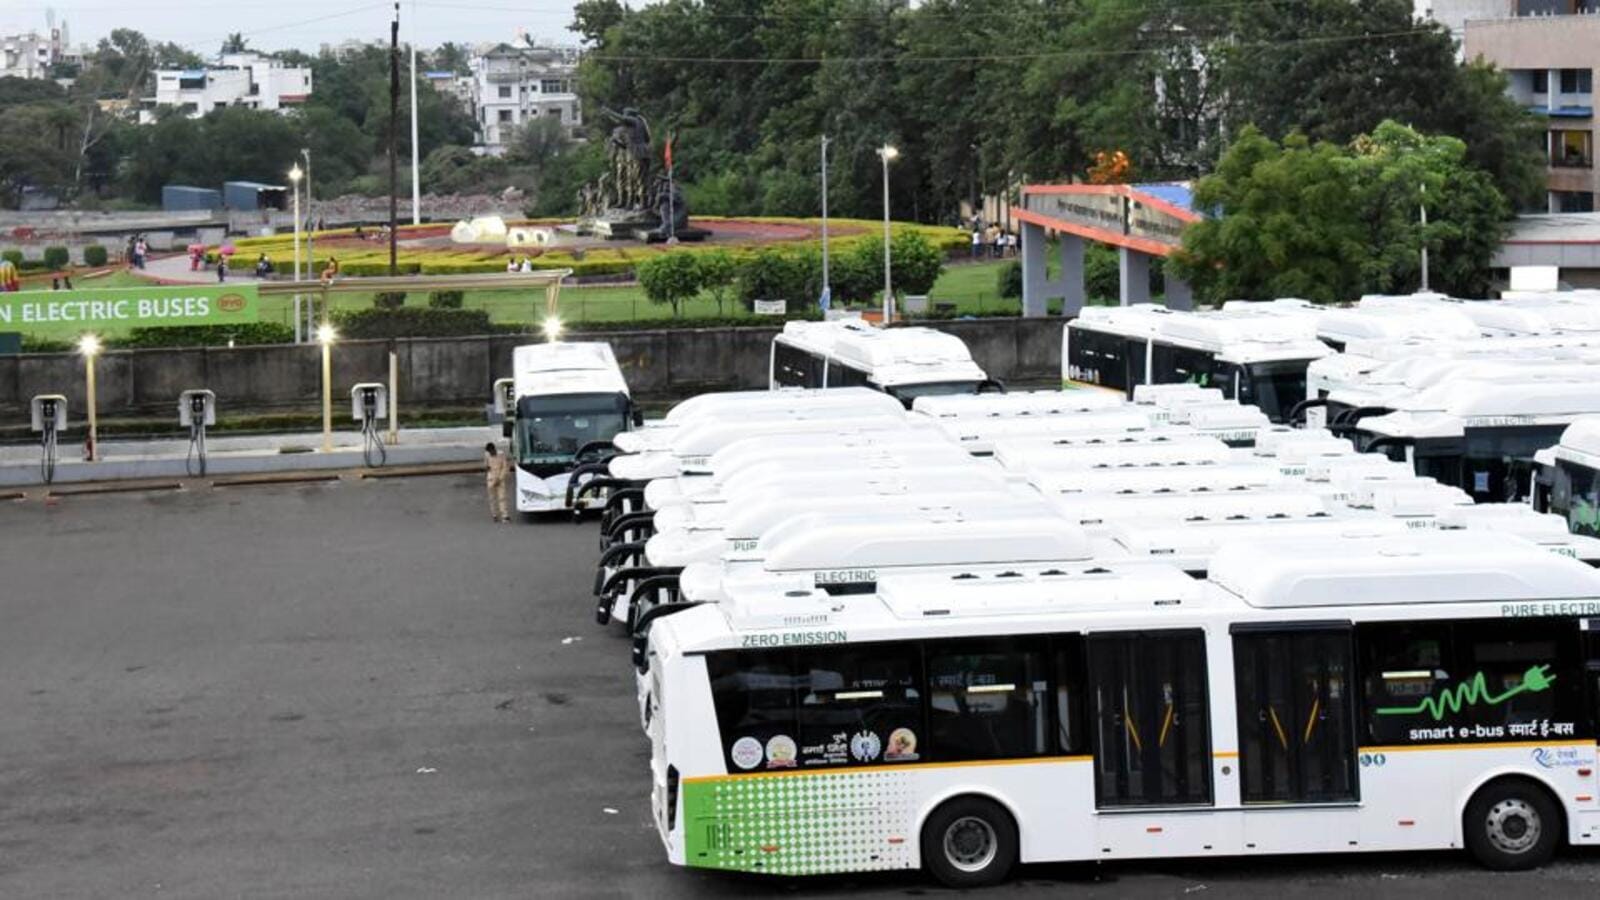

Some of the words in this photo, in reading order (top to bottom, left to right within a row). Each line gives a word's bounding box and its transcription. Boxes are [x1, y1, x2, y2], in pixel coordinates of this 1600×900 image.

[22, 301, 128, 322] ELECTRIC
[138, 297, 209, 318] BUSES
[814, 570, 876, 583] ELECTRIC
[1501, 604, 1538, 617] PURE
[741, 633, 780, 647] ZERO
[782, 630, 847, 645] EMISSION
[1409, 726, 1455, 740] smart
[1459, 724, 1504, 738] e-bus
[1508, 720, 1537, 736] स्मार्ट
[1540, 720, 1574, 738] ई-बस
